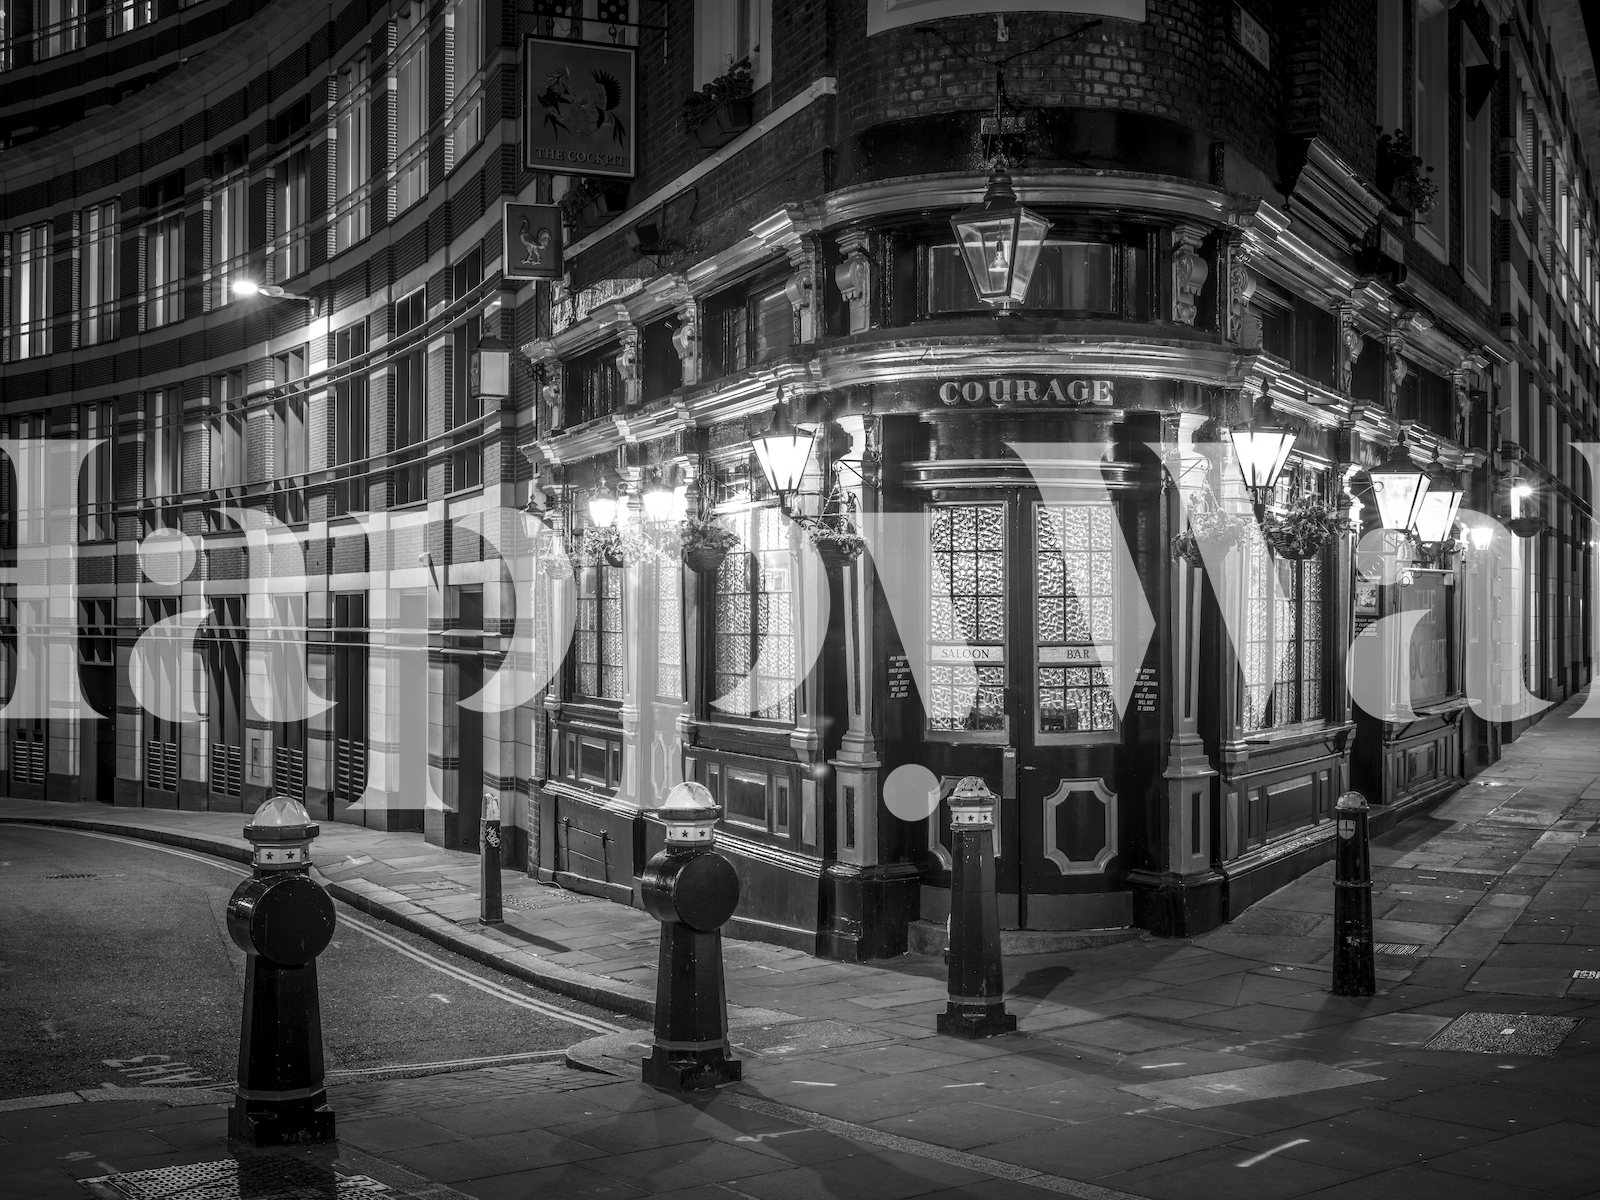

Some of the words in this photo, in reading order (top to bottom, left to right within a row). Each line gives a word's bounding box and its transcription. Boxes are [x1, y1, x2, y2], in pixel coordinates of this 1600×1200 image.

[535, 147, 565, 160] THE
[567, 150, 627, 167] COCKPIT
[938, 378, 1114, 406] COURAGE
[1414, 589, 1436, 625] THE
[941, 648, 990, 659] SALOON
[1066, 649, 1090, 659] BAR
